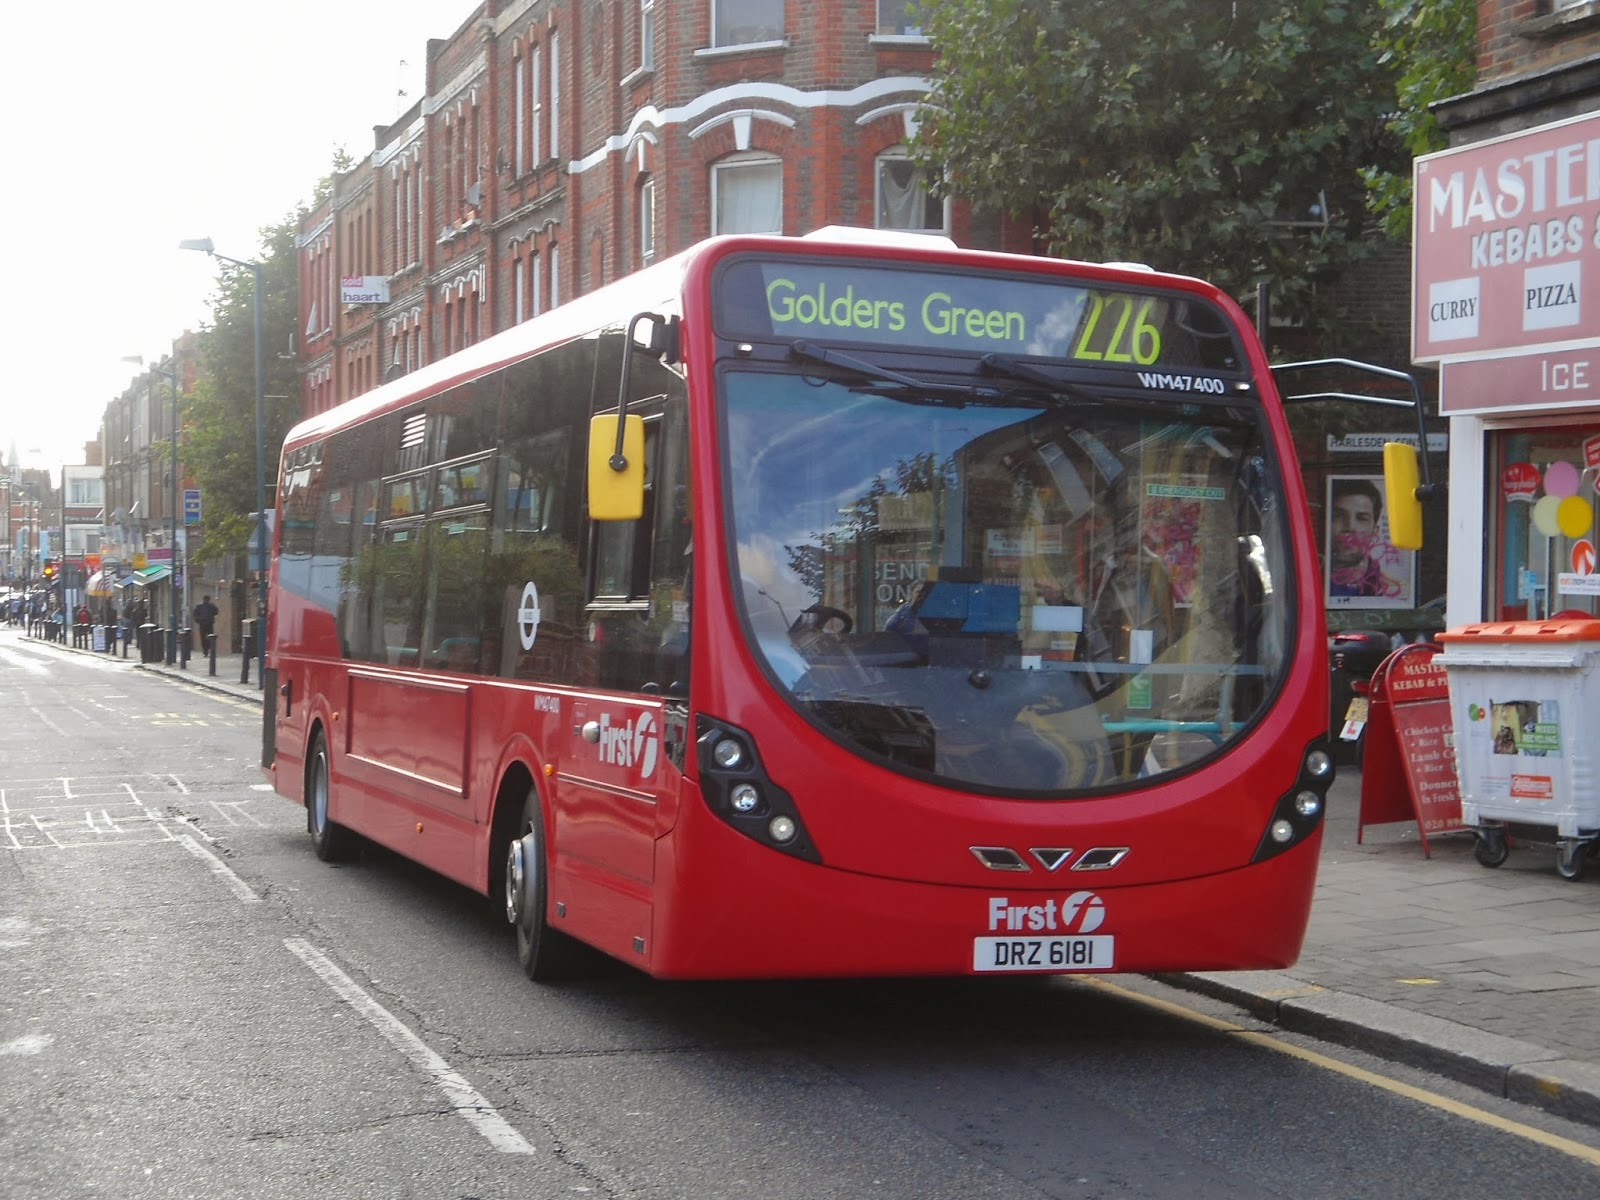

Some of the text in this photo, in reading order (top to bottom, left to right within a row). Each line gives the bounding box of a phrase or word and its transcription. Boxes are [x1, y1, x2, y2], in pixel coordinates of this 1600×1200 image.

[1471, 215, 1584, 269] KEBABS
[343, 292, 381, 302] haart
[1526, 282, 1577, 310] PIZZA
[766, 278, 1025, 341] Golders Green
[1431, 297, 1477, 322] CURRY
[1074, 289, 1161, 365] 226
[1137, 372, 1225, 394] WM47400
[1542, 360, 1590, 391] ICE
[1393, 679, 1424, 690] KEBAB
[1427, 678, 1435, 687] &
[599, 713, 632, 768] First
[1405, 726, 1440, 736] Chicken
[1411, 750, 1440, 762] Lamb
[1424, 764, 1444, 772] Rice
[1420, 781, 1457, 791] Donner
[1433, 792, 1455, 803] Fresh
[988, 897, 1057, 930] First
[995, 940, 1093, 966] DRZ 6181
